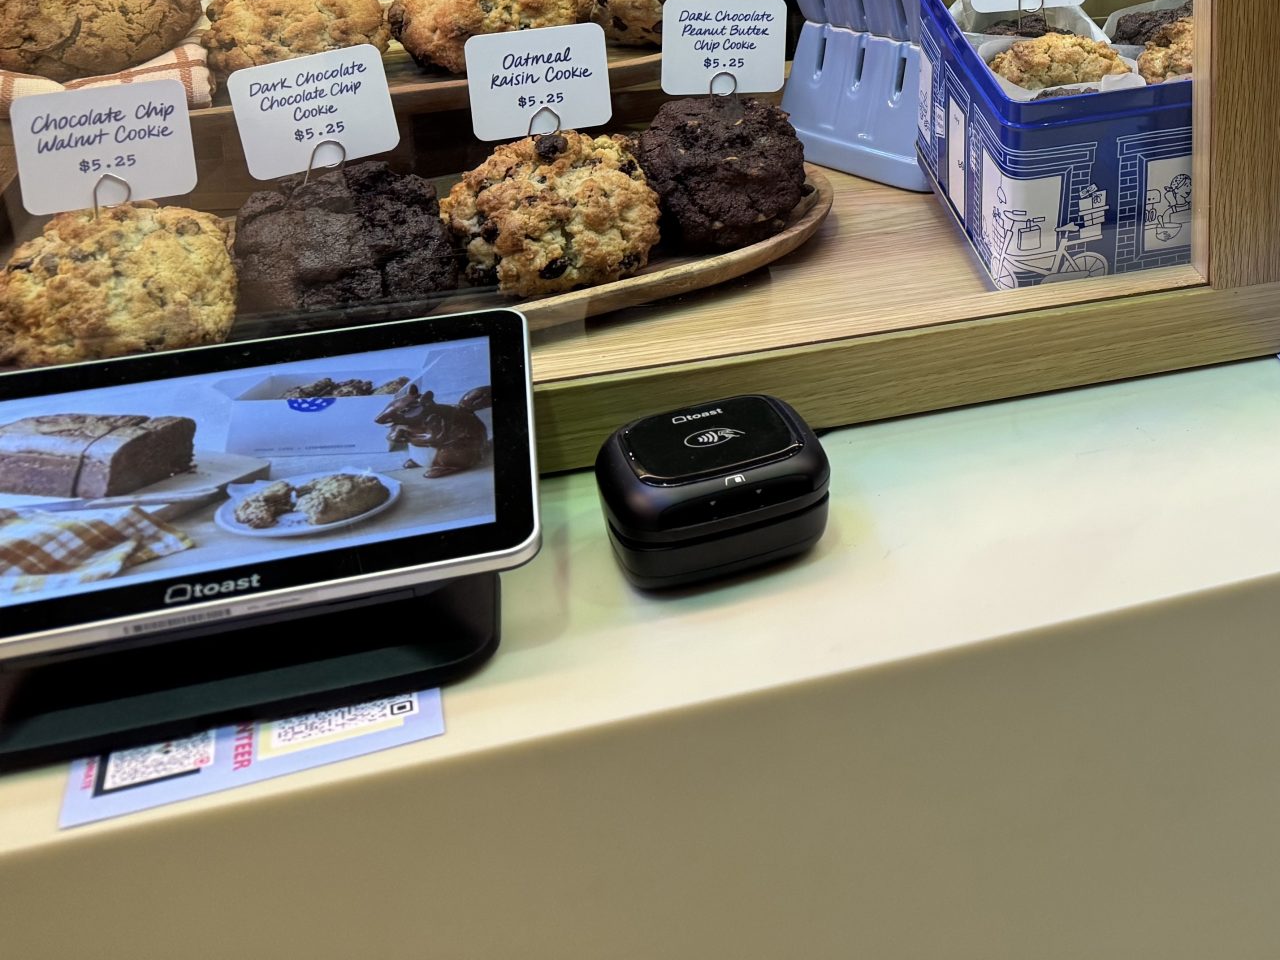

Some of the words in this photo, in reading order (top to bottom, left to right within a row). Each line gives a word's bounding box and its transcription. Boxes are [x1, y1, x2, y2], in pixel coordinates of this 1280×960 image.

[679, 10, 712, 22] Dark
[715, 10, 774, 22] Chocolate
[682, 24, 728, 36] Peanut
[729, 25, 770, 36] Butter
[694, 39, 720, 52] Chip
[722, 39, 757, 51] Cookie
[502, 47, 572, 70] Oatmeal
[703, 57, 745, 69] $5.25
[249, 77, 292, 97] Dark
[295, 61, 366, 86] Chocolate
[490, 71, 540, 89] Raisin
[545, 66, 593, 82] Cookie
[260, 86, 328, 111] Chocolate
[330, 80, 362, 96] Chip
[518, 92, 564, 108] $5.25
[31, 106, 126, 134] Chocolate
[135, 101, 175, 122] Chip
[293, 103, 338, 121] Cookie
[37, 129, 110, 154] Walnut
[114, 124, 173, 143] Cookie
[294, 121, 345, 142] $5.25
[79, 154, 137, 173] $5.25
[686, 408, 723, 421] toast
[193, 573, 261, 597] toast
[232, 721, 254, 771] NTEER
